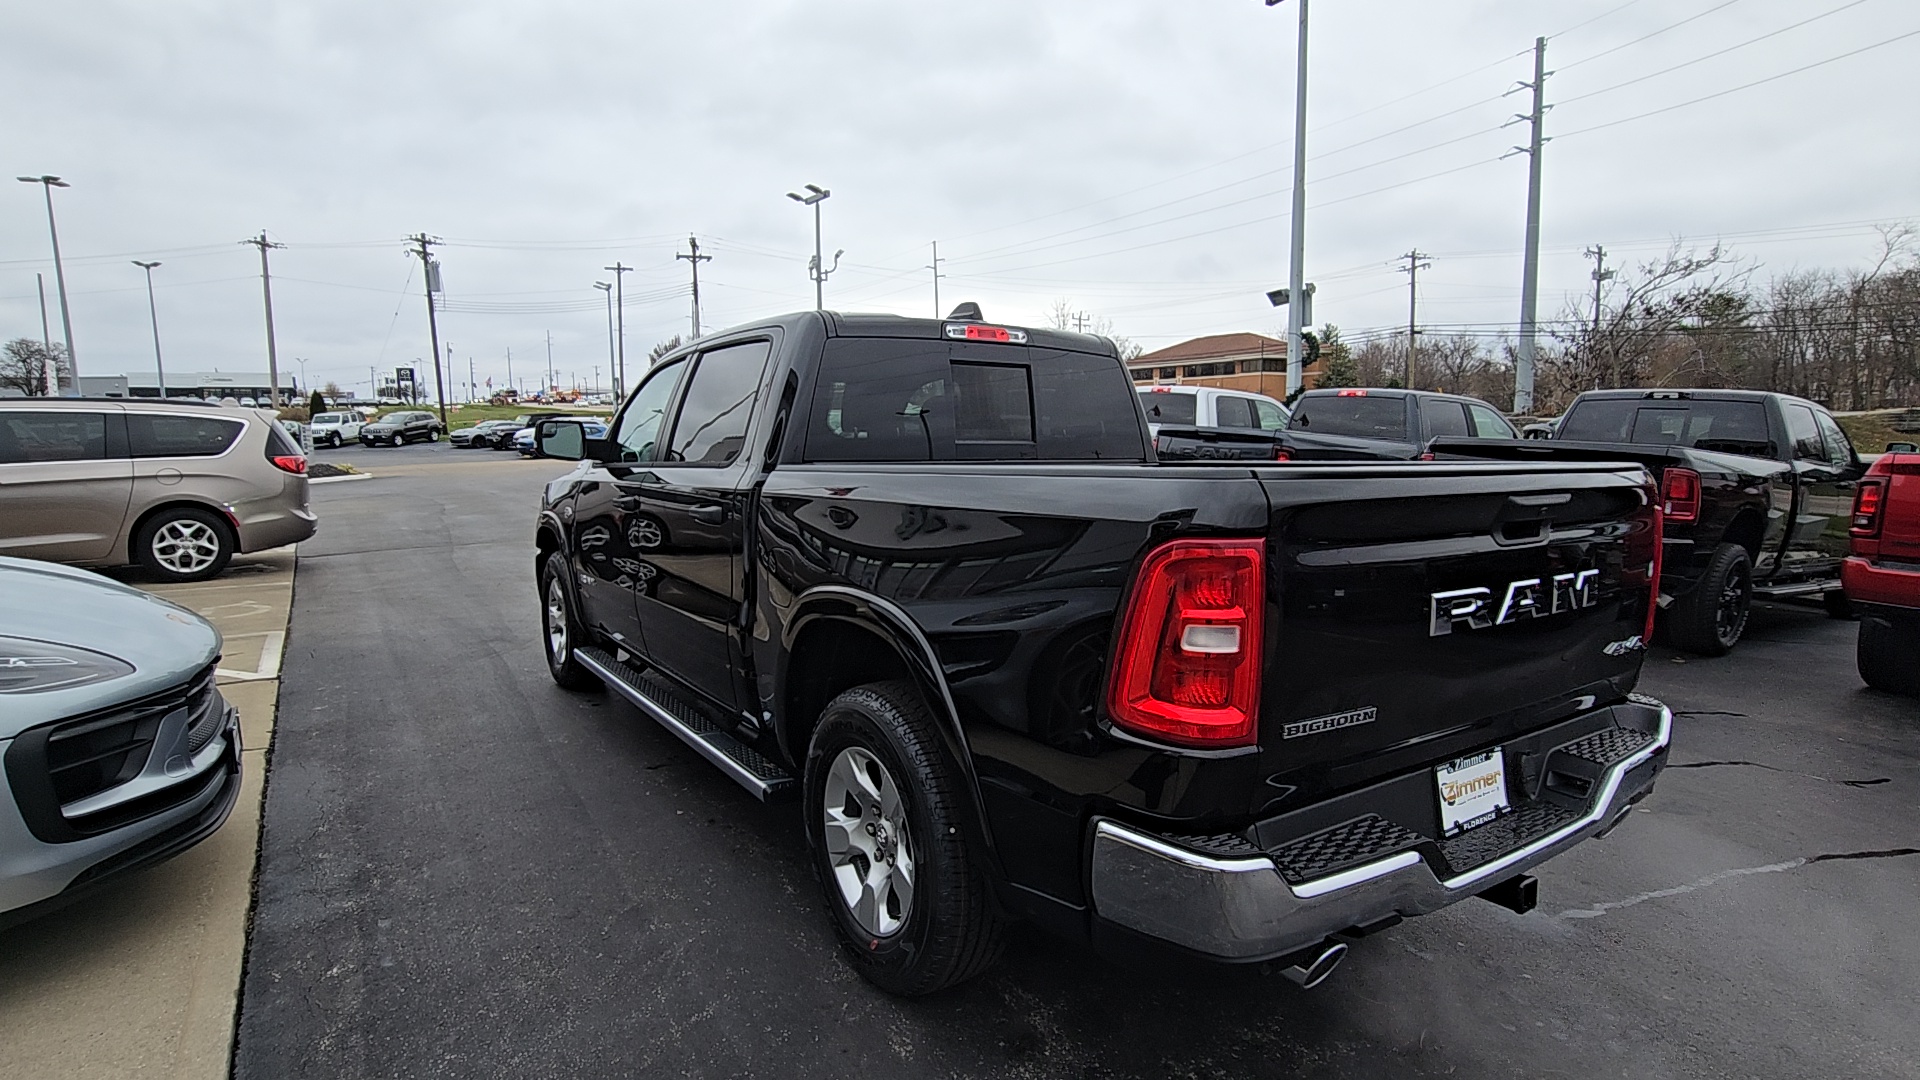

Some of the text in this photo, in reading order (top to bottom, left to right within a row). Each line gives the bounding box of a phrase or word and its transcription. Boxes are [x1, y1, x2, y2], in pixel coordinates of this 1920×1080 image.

[1182, 446, 1241, 459] RAM
[1429, 568, 1600, 637] RAM
[1284, 709, 1377, 737] BIGHORN
[1454, 752, 1487, 772] Zimmer
[1443, 770, 1502, 802] Zimmer
[1463, 811, 1497, 831] FLORENCE
